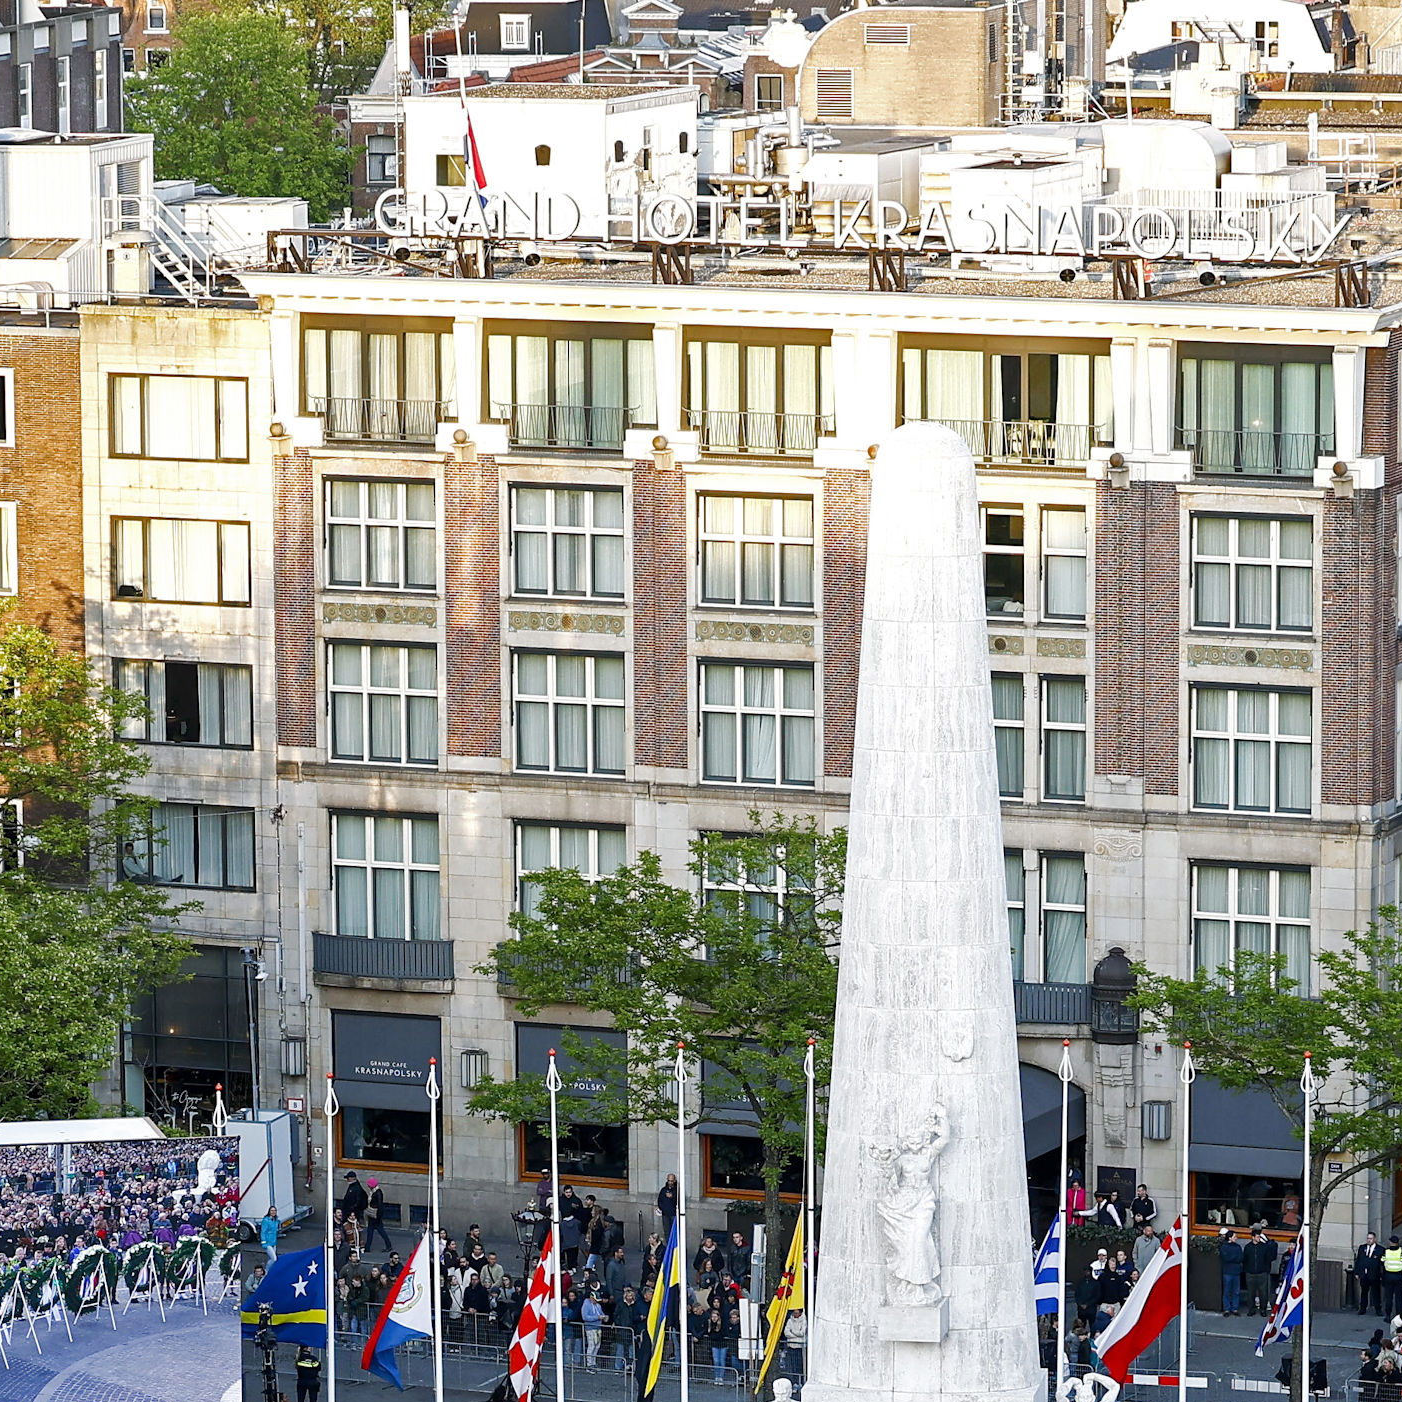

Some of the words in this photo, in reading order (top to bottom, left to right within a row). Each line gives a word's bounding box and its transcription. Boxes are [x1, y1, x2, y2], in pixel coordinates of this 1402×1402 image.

[374, 187, 581, 240] GRAND
[602, 193, 809, 246] HOTEL
[833, 199, 1353, 264] KRASNAPOLSKY
[355, 1066, 423, 1078] KRASNAPOLSKY
